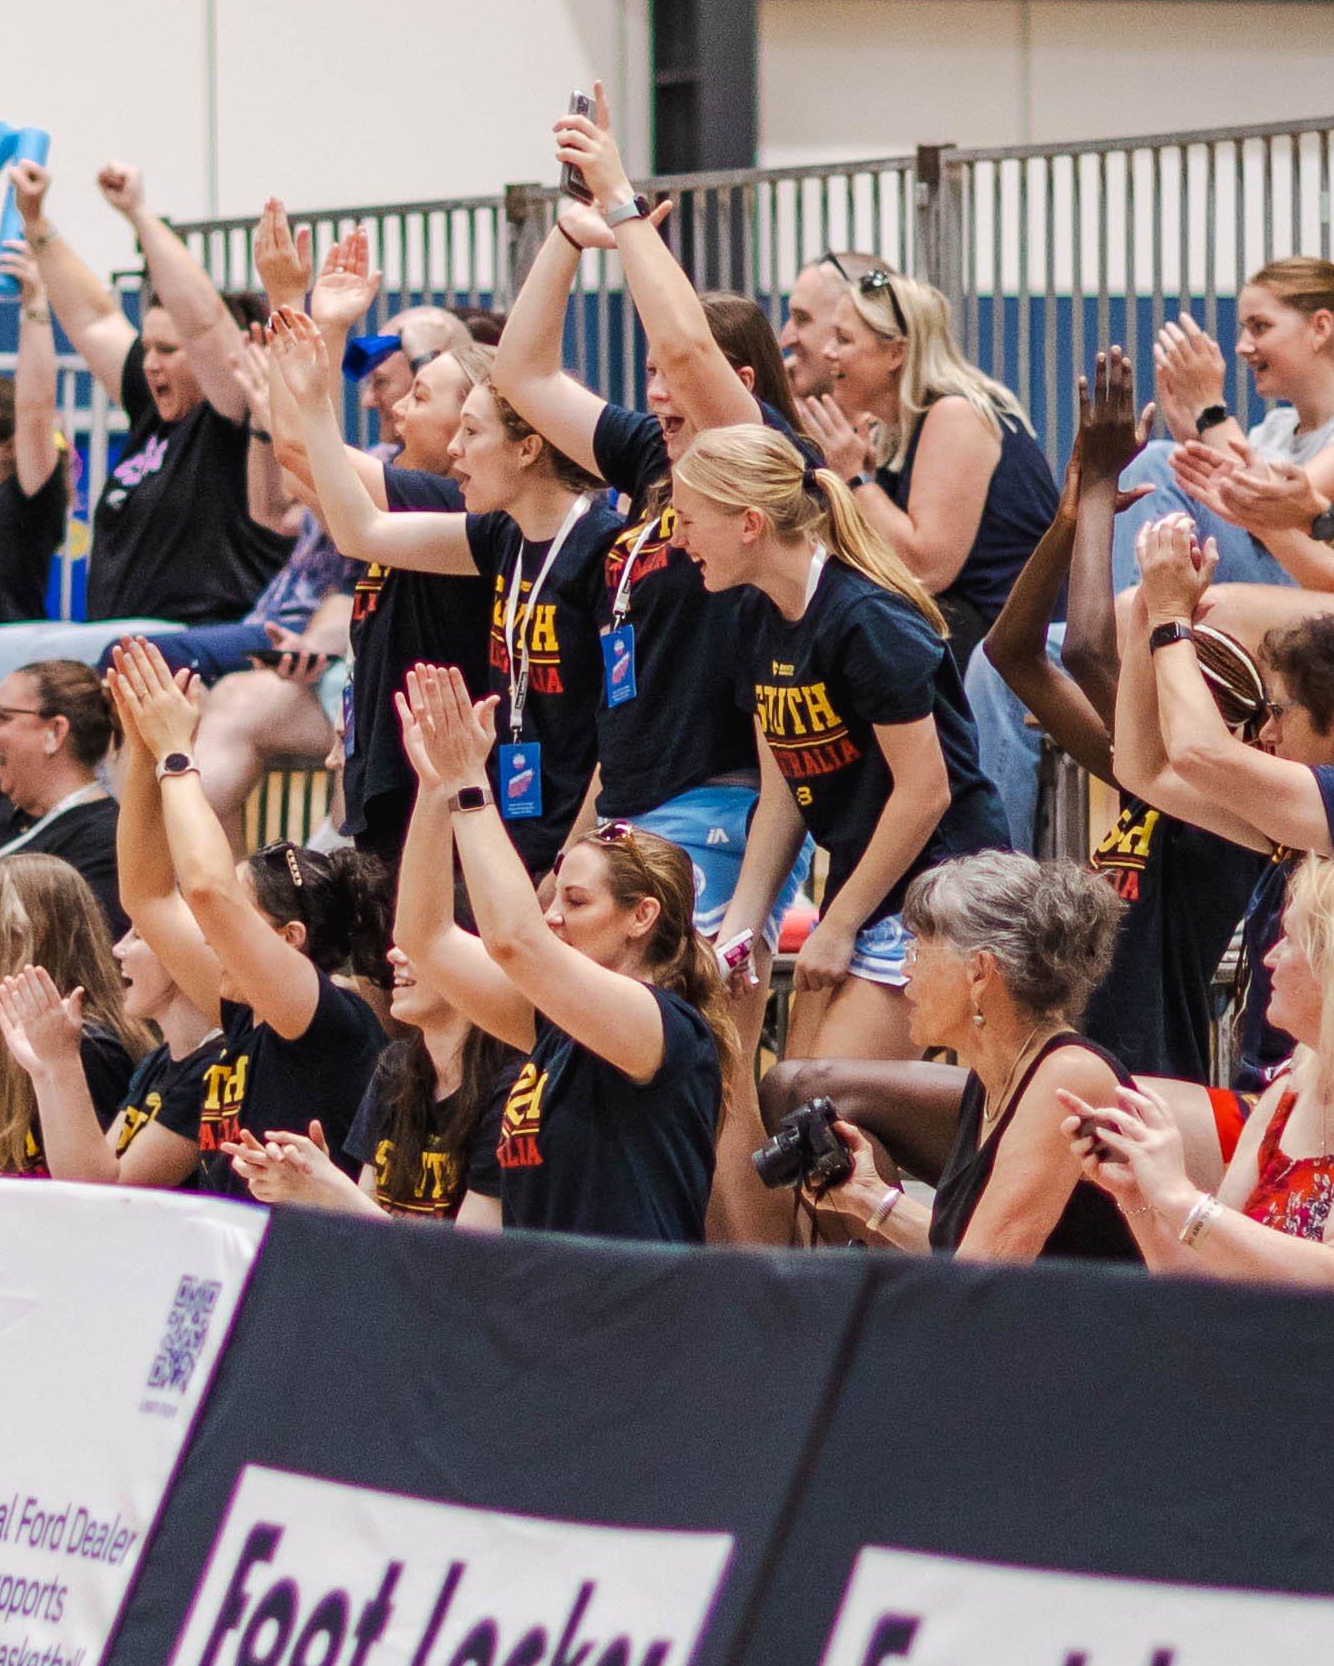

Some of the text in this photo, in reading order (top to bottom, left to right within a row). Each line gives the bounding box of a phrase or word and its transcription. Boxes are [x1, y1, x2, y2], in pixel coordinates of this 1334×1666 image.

[754, 682, 843, 735] SUTH
[14, 1496, 72, 1551] Ford
[66, 1502, 138, 1565] Dealer
